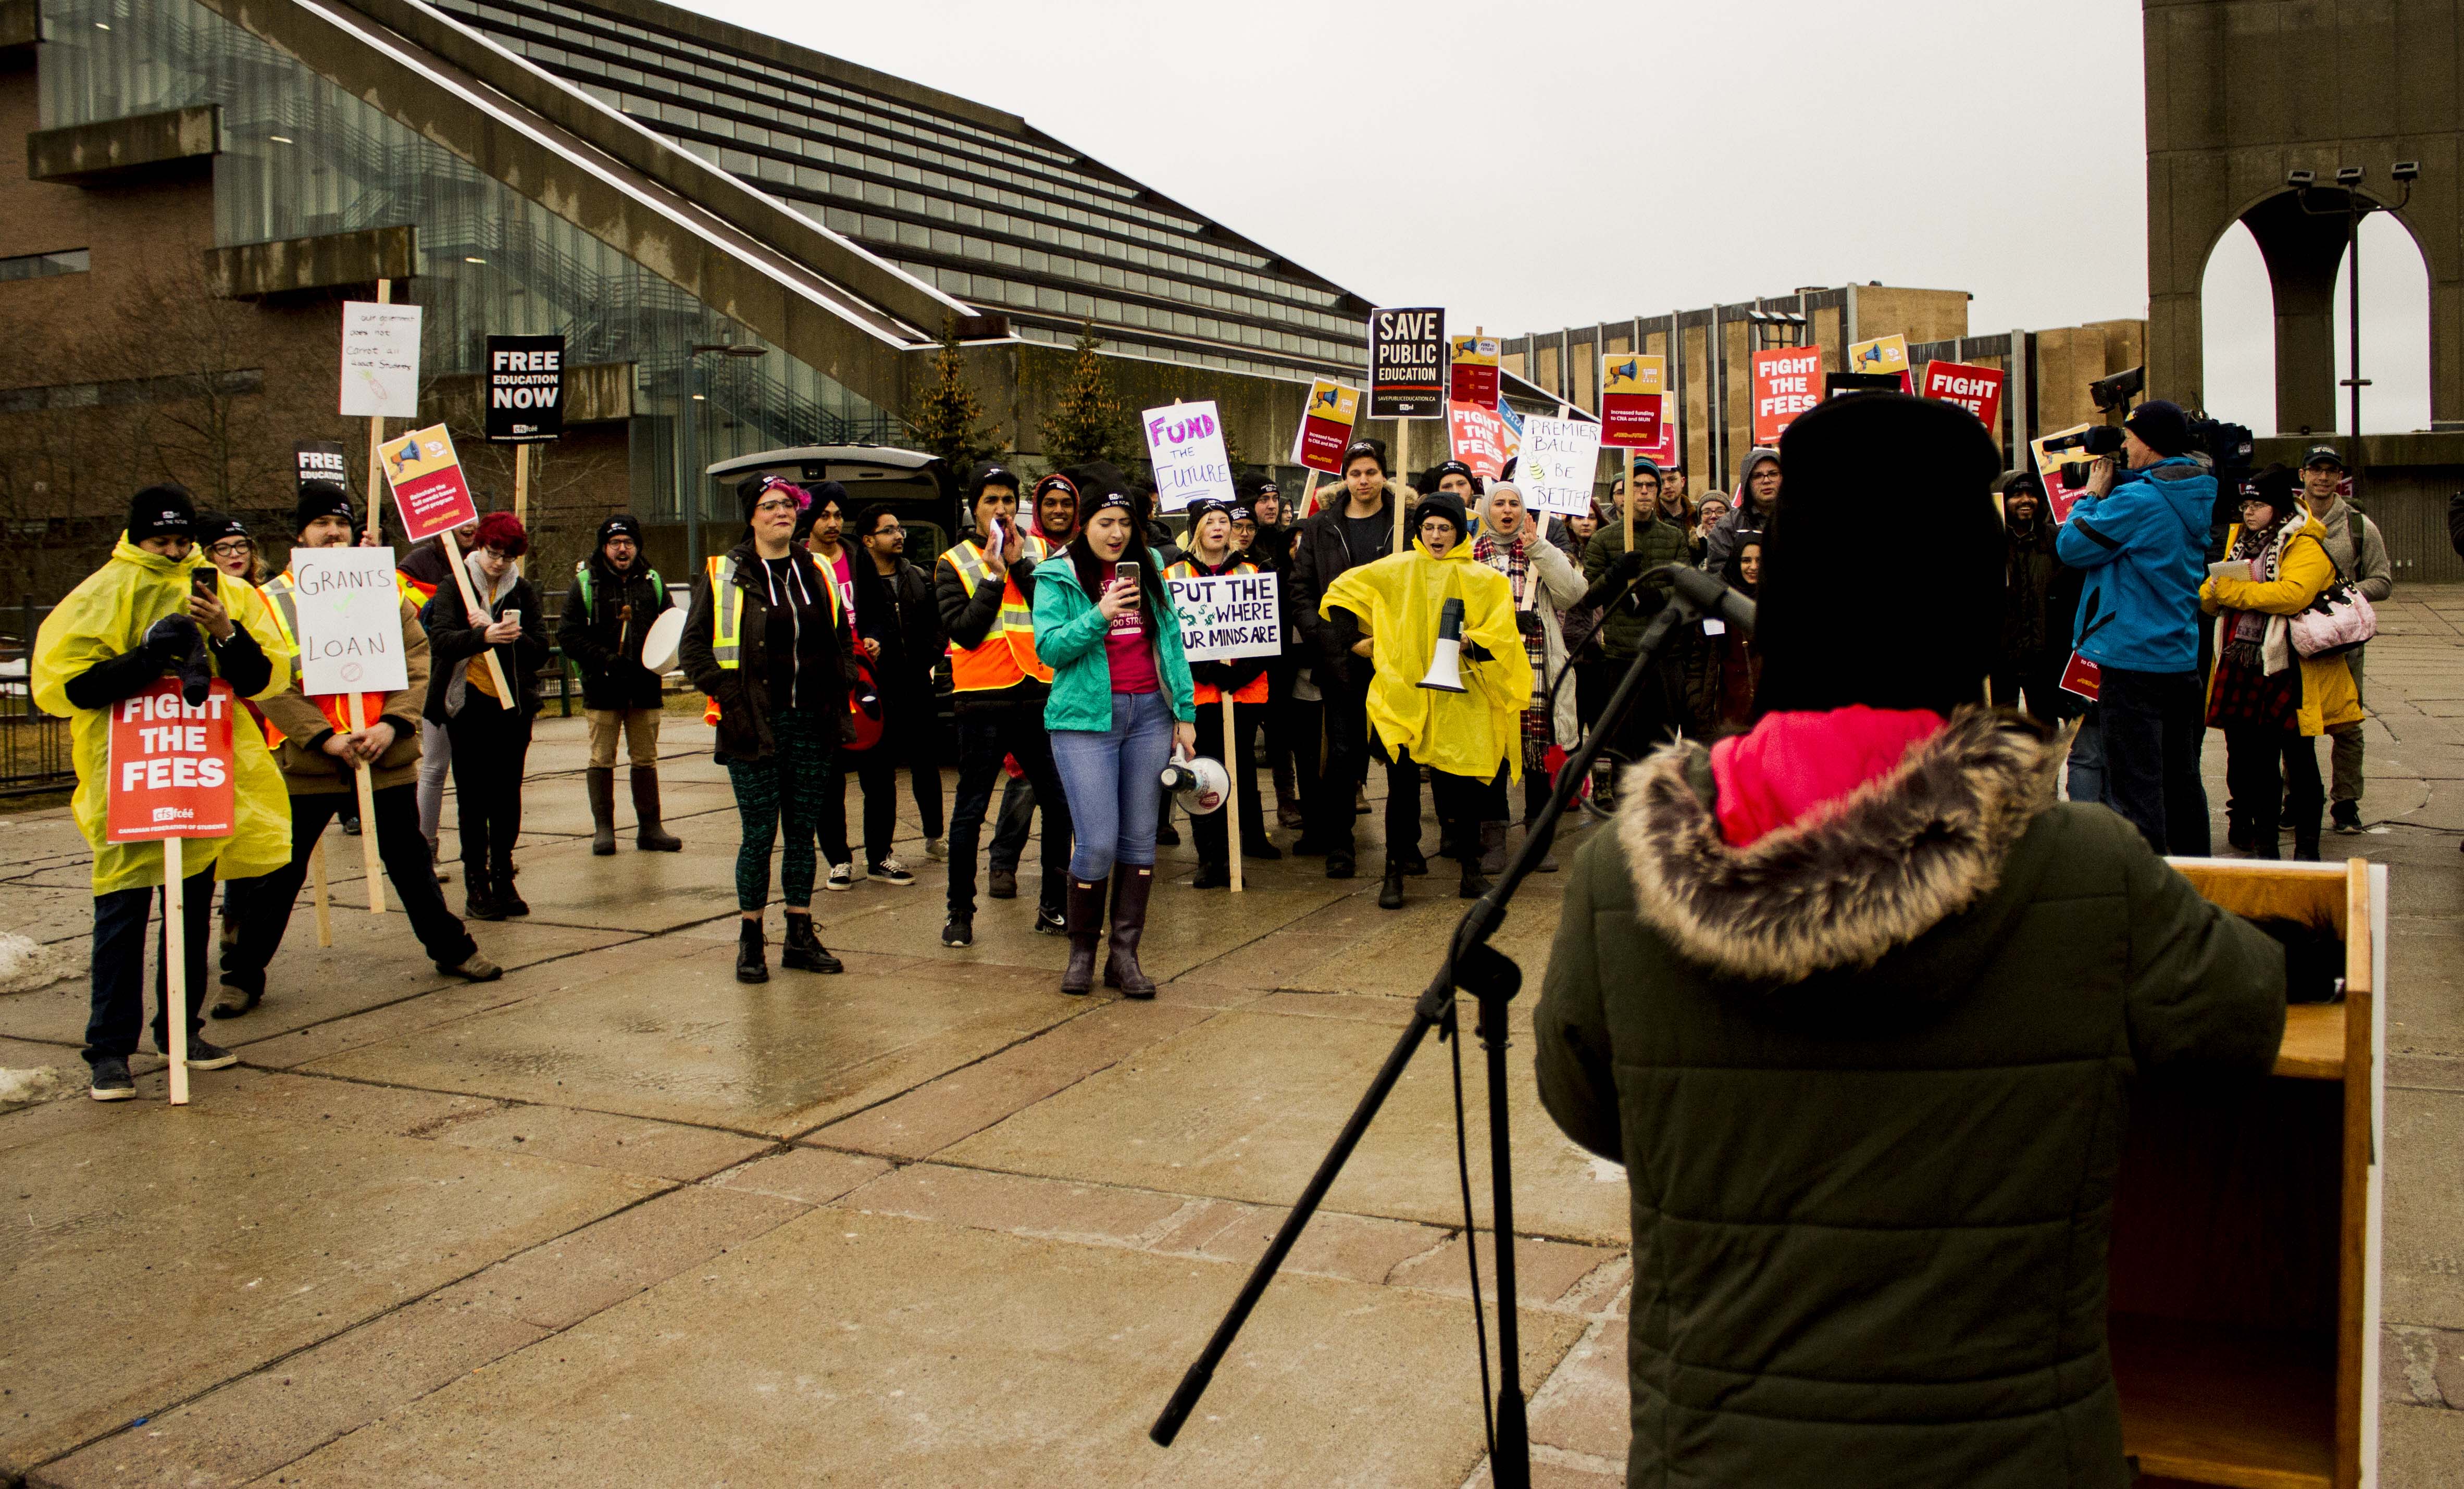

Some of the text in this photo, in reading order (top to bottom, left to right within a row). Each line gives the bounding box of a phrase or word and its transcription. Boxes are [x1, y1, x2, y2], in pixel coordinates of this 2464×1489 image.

[1379, 312, 1437, 341] SAVE
[493, 351, 560, 371] FREE
[1379, 344, 1437, 364] PUBLIC
[1379, 367, 1436, 381] EDUCATION
[1759, 356, 1817, 378] FIGHT
[493, 374, 558, 385] EDUCATION
[1769, 377, 1808, 395] THE
[1932, 373, 1997, 398] FIGHT
[493, 387, 559, 409] NOW
[1761, 394, 1817, 417] FEES
[1148, 414, 1215, 447] FUND
[1453, 409, 1500, 433] FIGHT
[1531, 419, 1598, 441] PREMIER
[1309, 431, 1342, 444] Increased funding
[1463, 424, 1495, 445] THE
[1532, 436, 1584, 455] BALL,
[298, 452, 344, 470] FREE
[1169, 446, 1195, 459] THE
[1457, 439, 1504, 464] FEES
[300, 471, 344, 481] EDUCATION
[1156, 464, 1227, 498] FUTURE
[1555, 463, 1576, 479] BE
[409, 487, 436, 500] Reinstate
[1532, 486, 1590, 511] BETTER
[415, 496, 454, 515] grant program
[298, 564, 391, 595] GRANTS
[1167, 578, 1274, 604] PUT THE
[1215, 603, 1273, 623] WHERE
[309, 632, 385, 661] LOAN
[1181, 625, 1277, 649] UR MINDS ARE
[122, 693, 227, 723] FIGHT
[139, 725, 207, 754] THE
[122, 757, 226, 792] FEES
